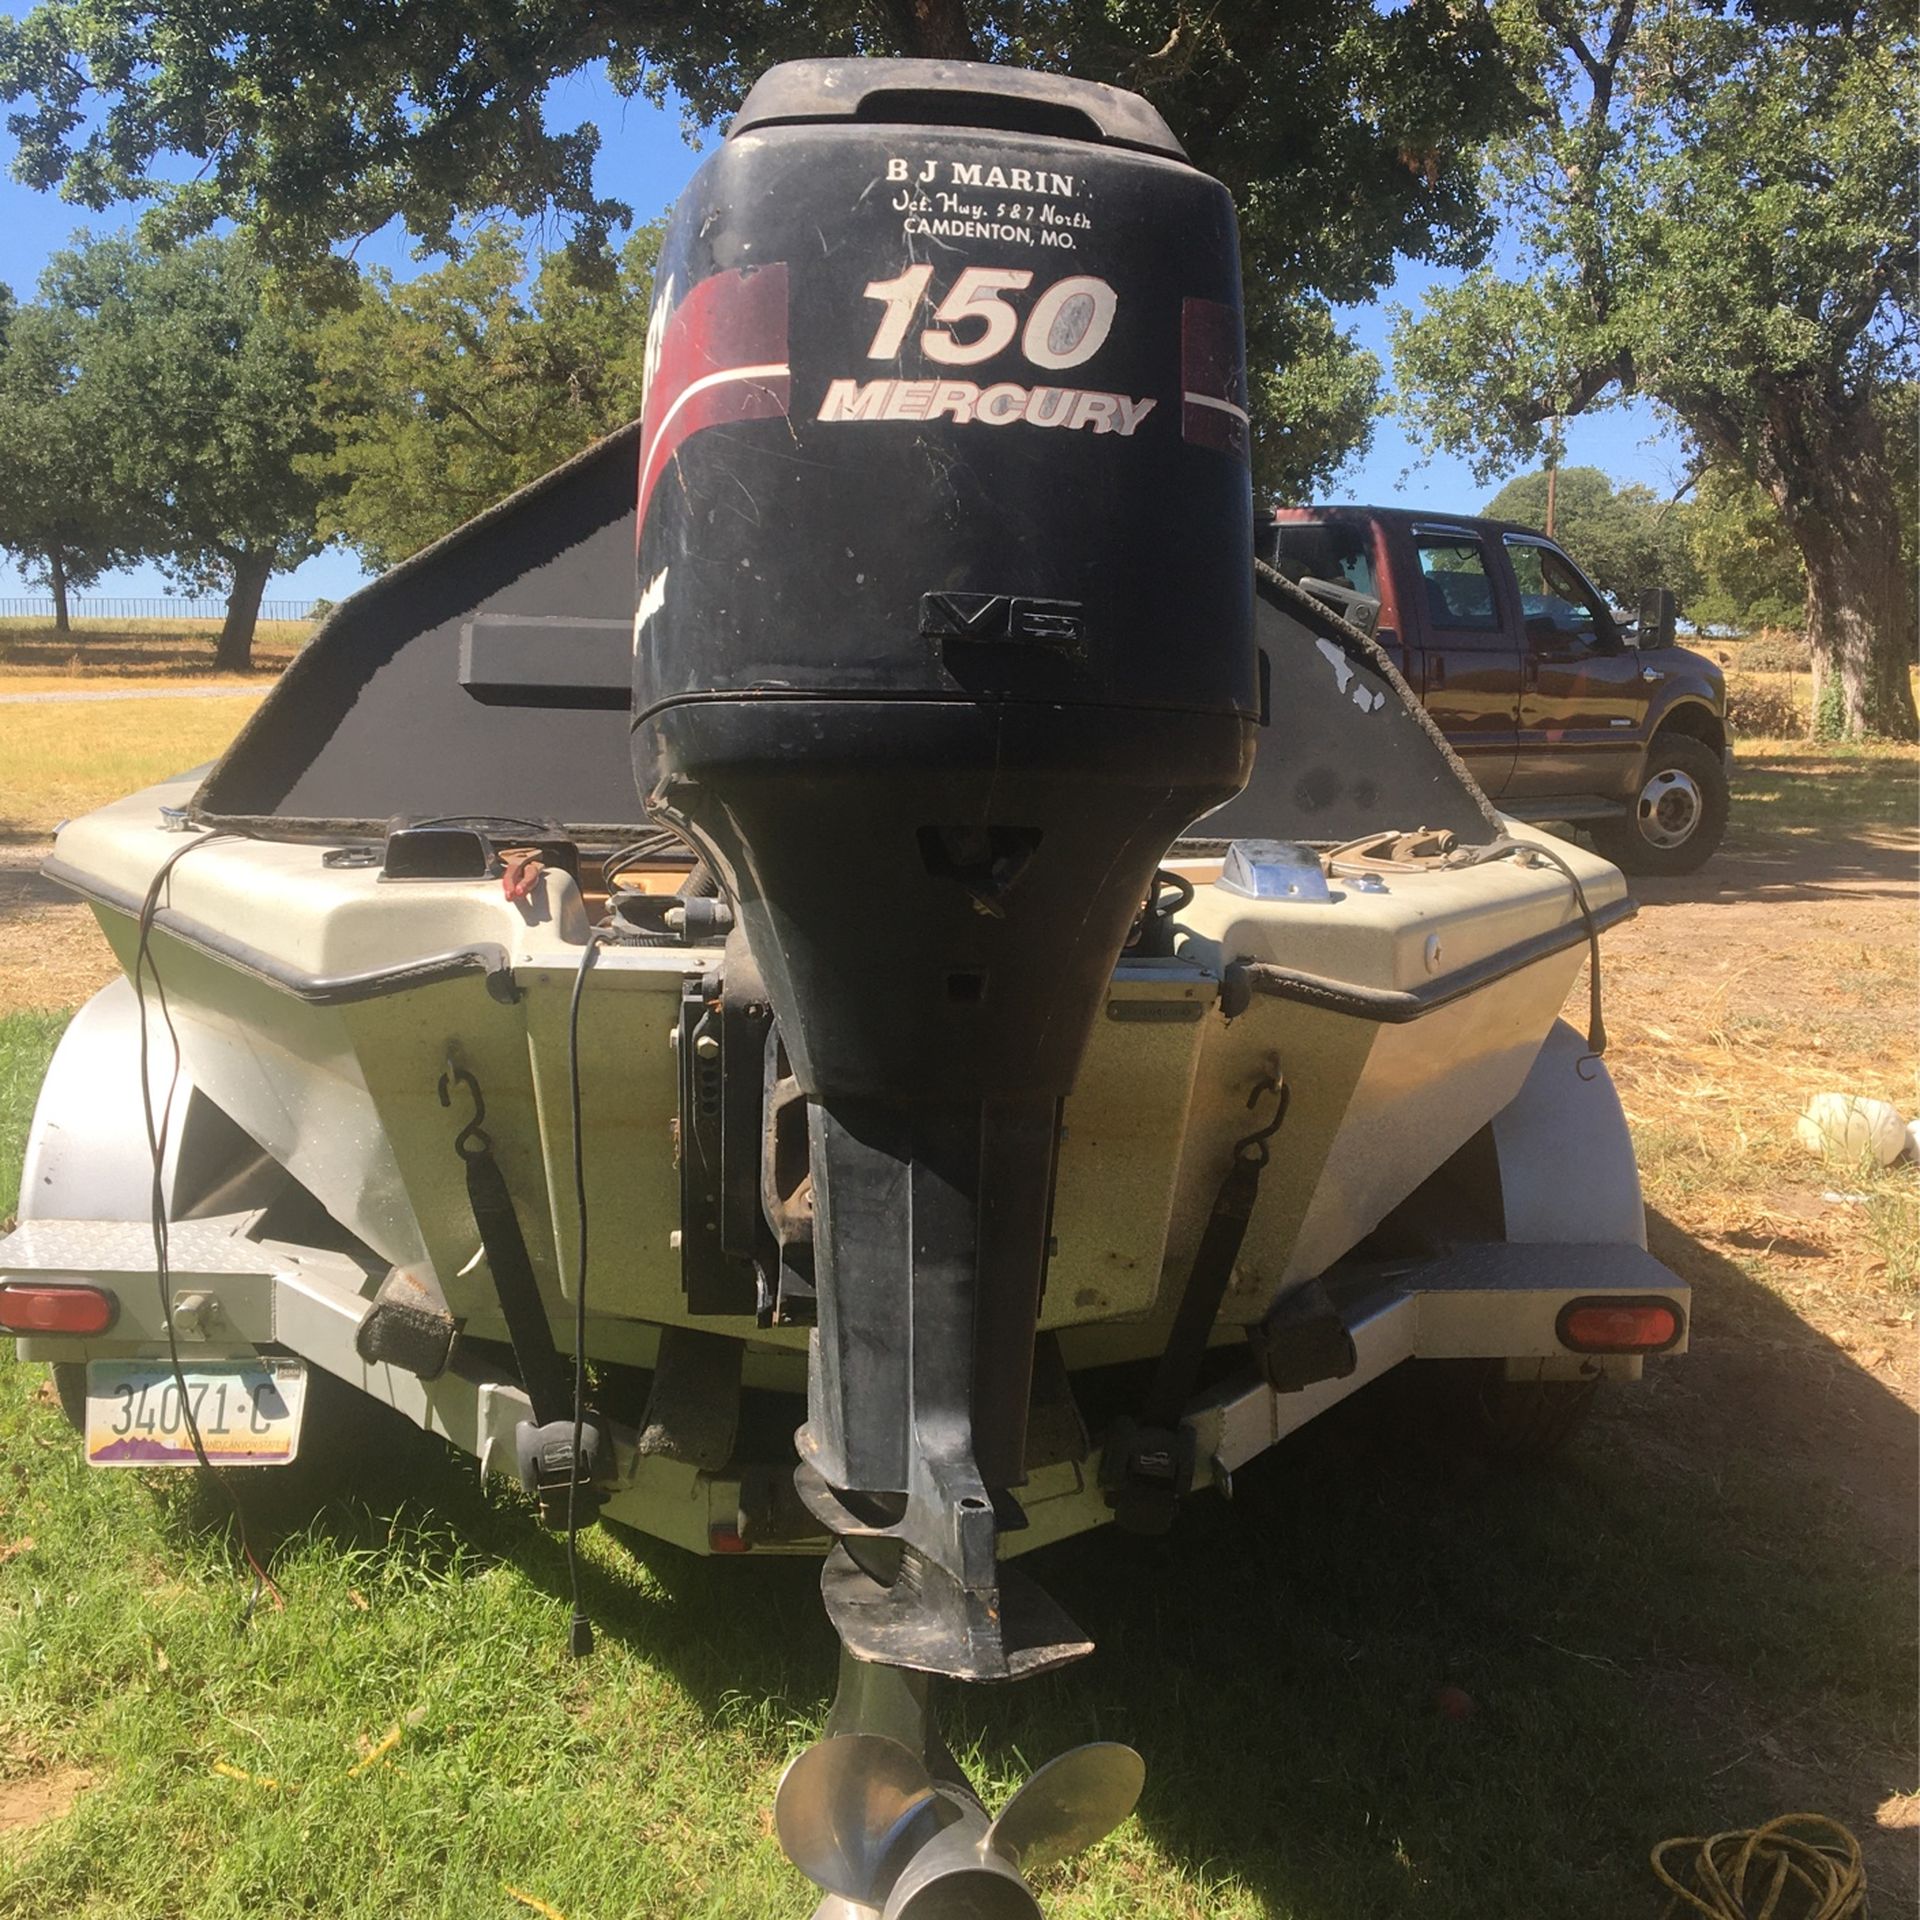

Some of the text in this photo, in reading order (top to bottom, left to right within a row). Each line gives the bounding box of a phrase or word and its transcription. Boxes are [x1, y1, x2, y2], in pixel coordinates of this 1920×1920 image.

[886, 158, 1093, 199] B J MARIN
[904, 217, 1077, 249] CAMDENTON, MO.
[936, 192, 988, 219] Hwy.
[997, 204, 1006, 218] 5
[1009, 204, 1021, 219] &
[1025, 207, 1034, 221] 7
[1039, 203, 1092, 229] North
[863, 263, 1118, 371] 150
[816, 378, 1158, 436] MERCURY
[919, 591, 1084, 640] V6
